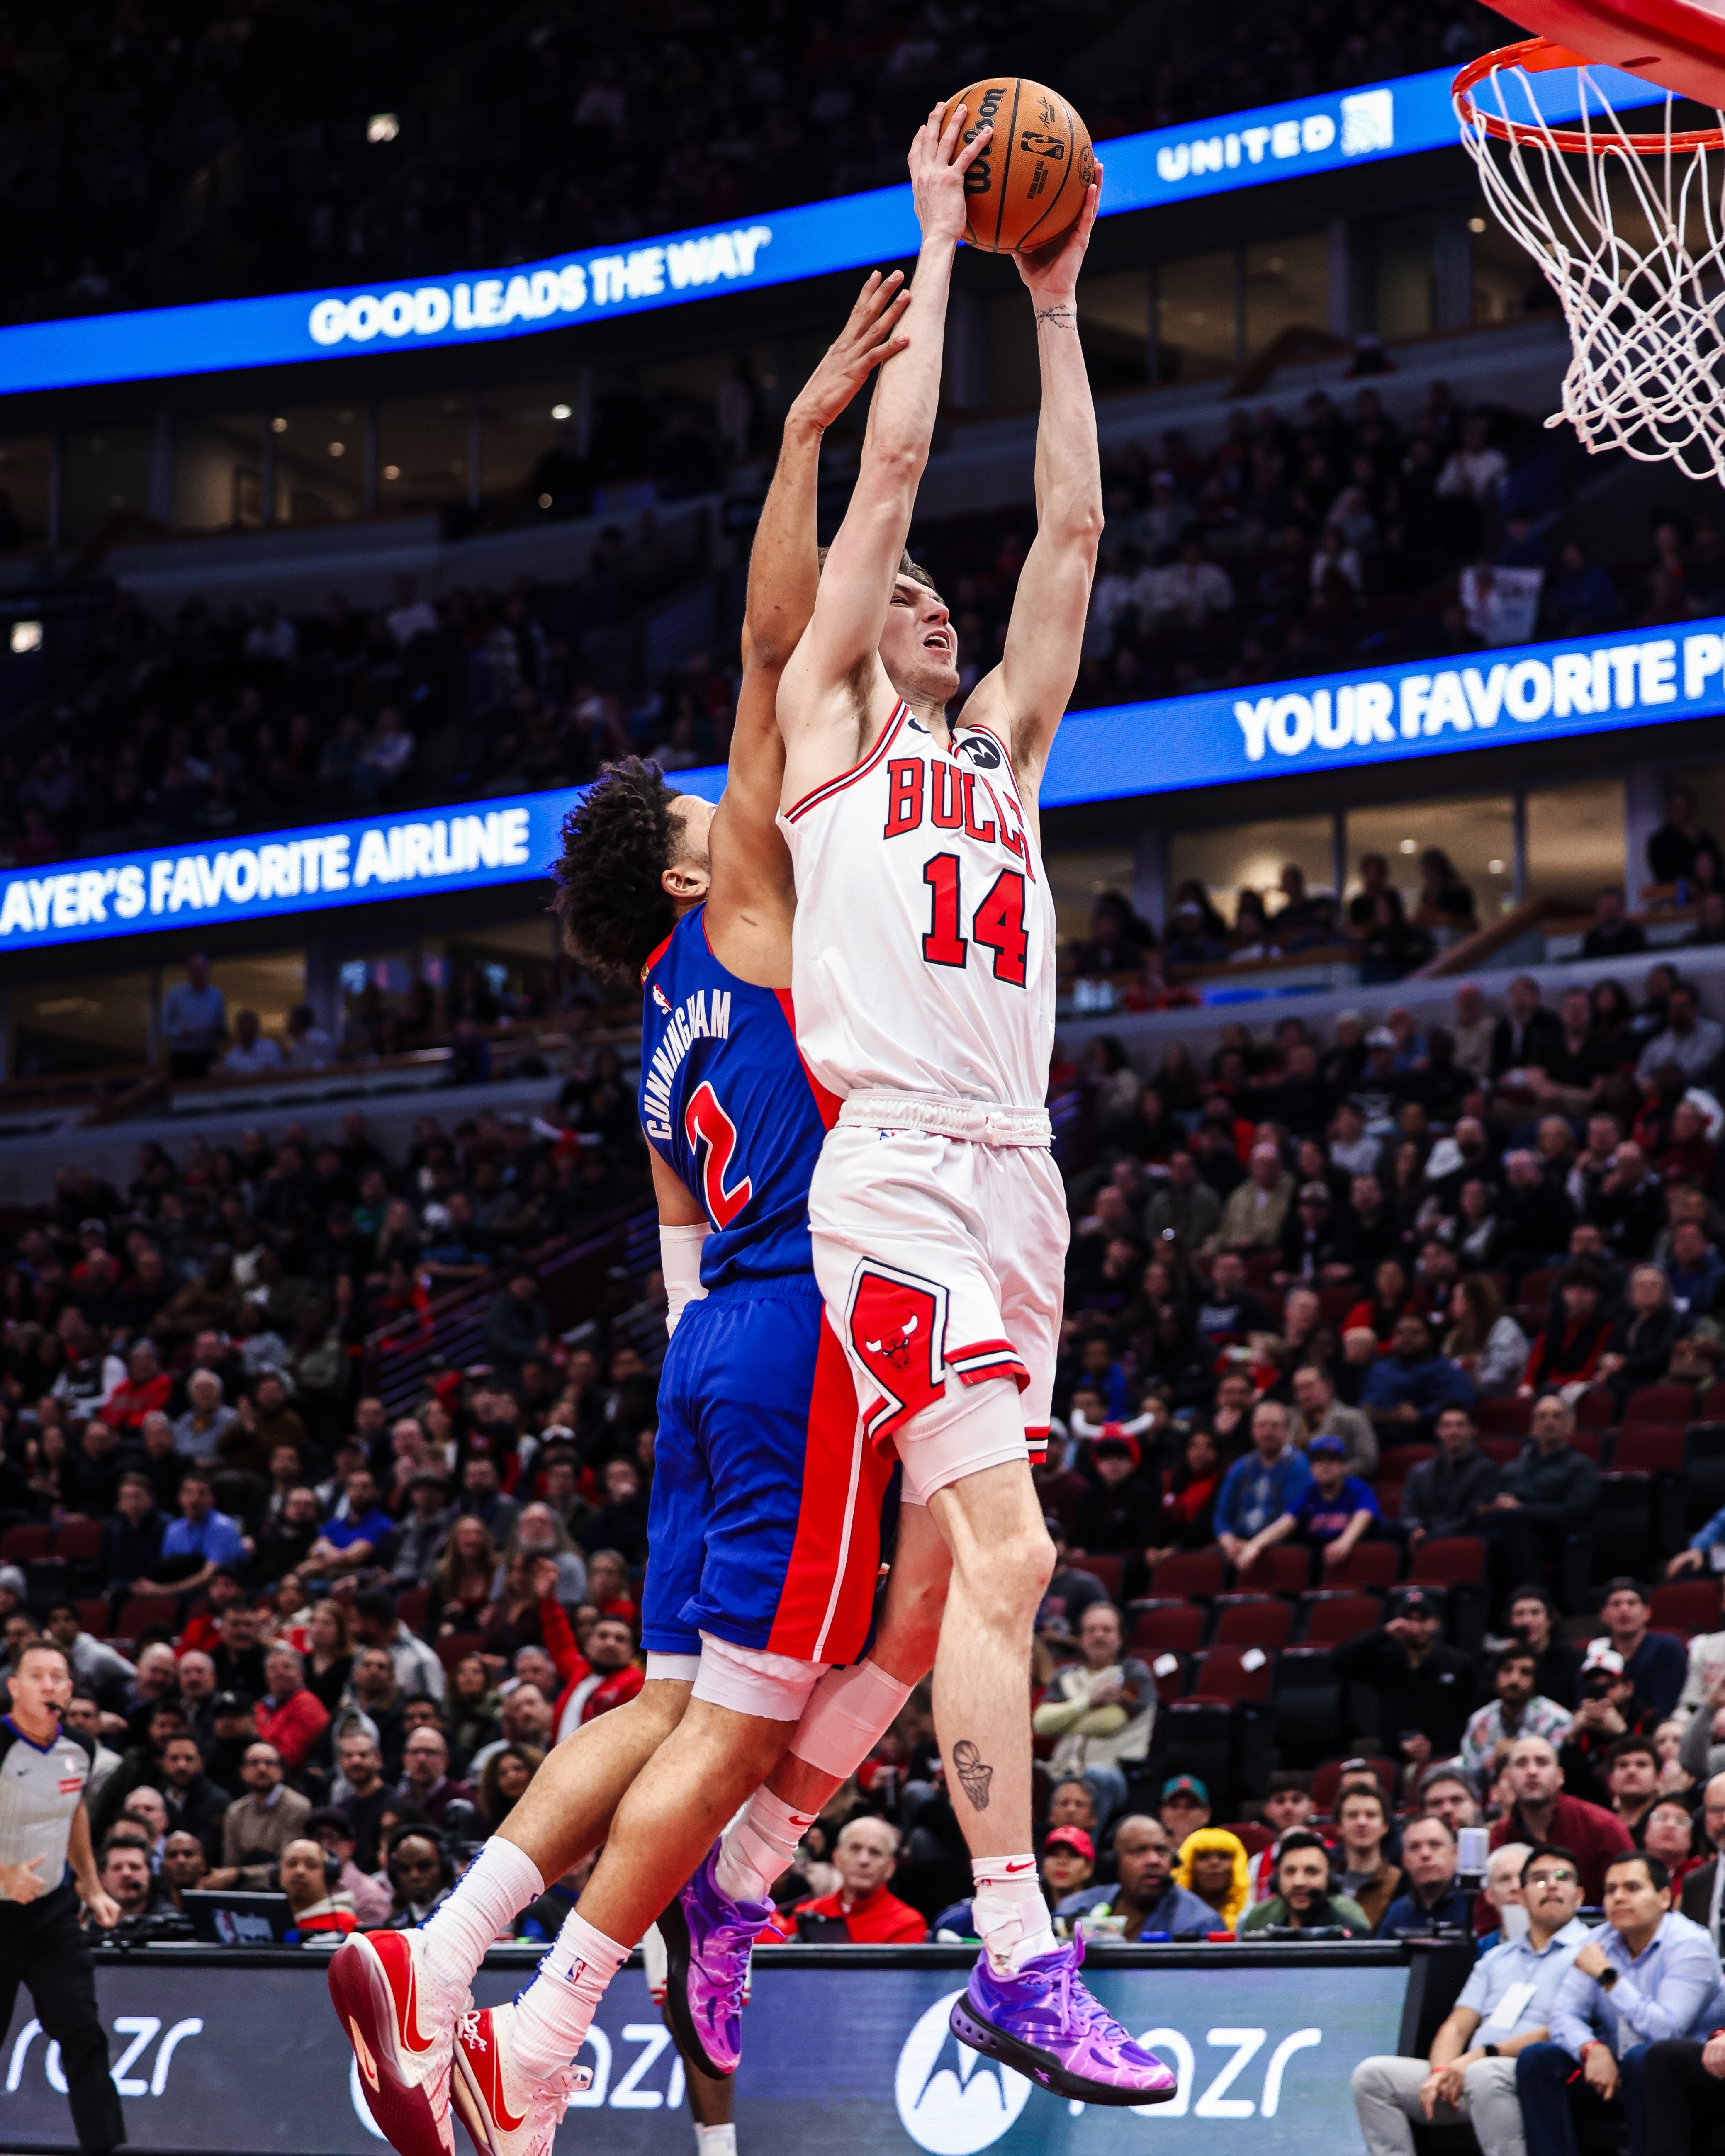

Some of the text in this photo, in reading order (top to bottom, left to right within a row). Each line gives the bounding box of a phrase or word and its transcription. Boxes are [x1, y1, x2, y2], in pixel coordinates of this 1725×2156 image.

[1157, 115, 1336, 181] UNITED
[310, 287, 451, 345] GOOD
[453, 265, 587, 329] LEADS
[588, 244, 665, 306] THE
[1234, 633, 1725, 761] YOUR FAVORITE P
[0, 808, 530, 936] AYER'S FAVORITE AIRLINE
[922, 851, 1029, 989] 14
[644, 989, 731, 1140] CUNNINGHAM
[684, 1079, 752, 1232] 2
[1068, 2027, 1323, 2118] azr
